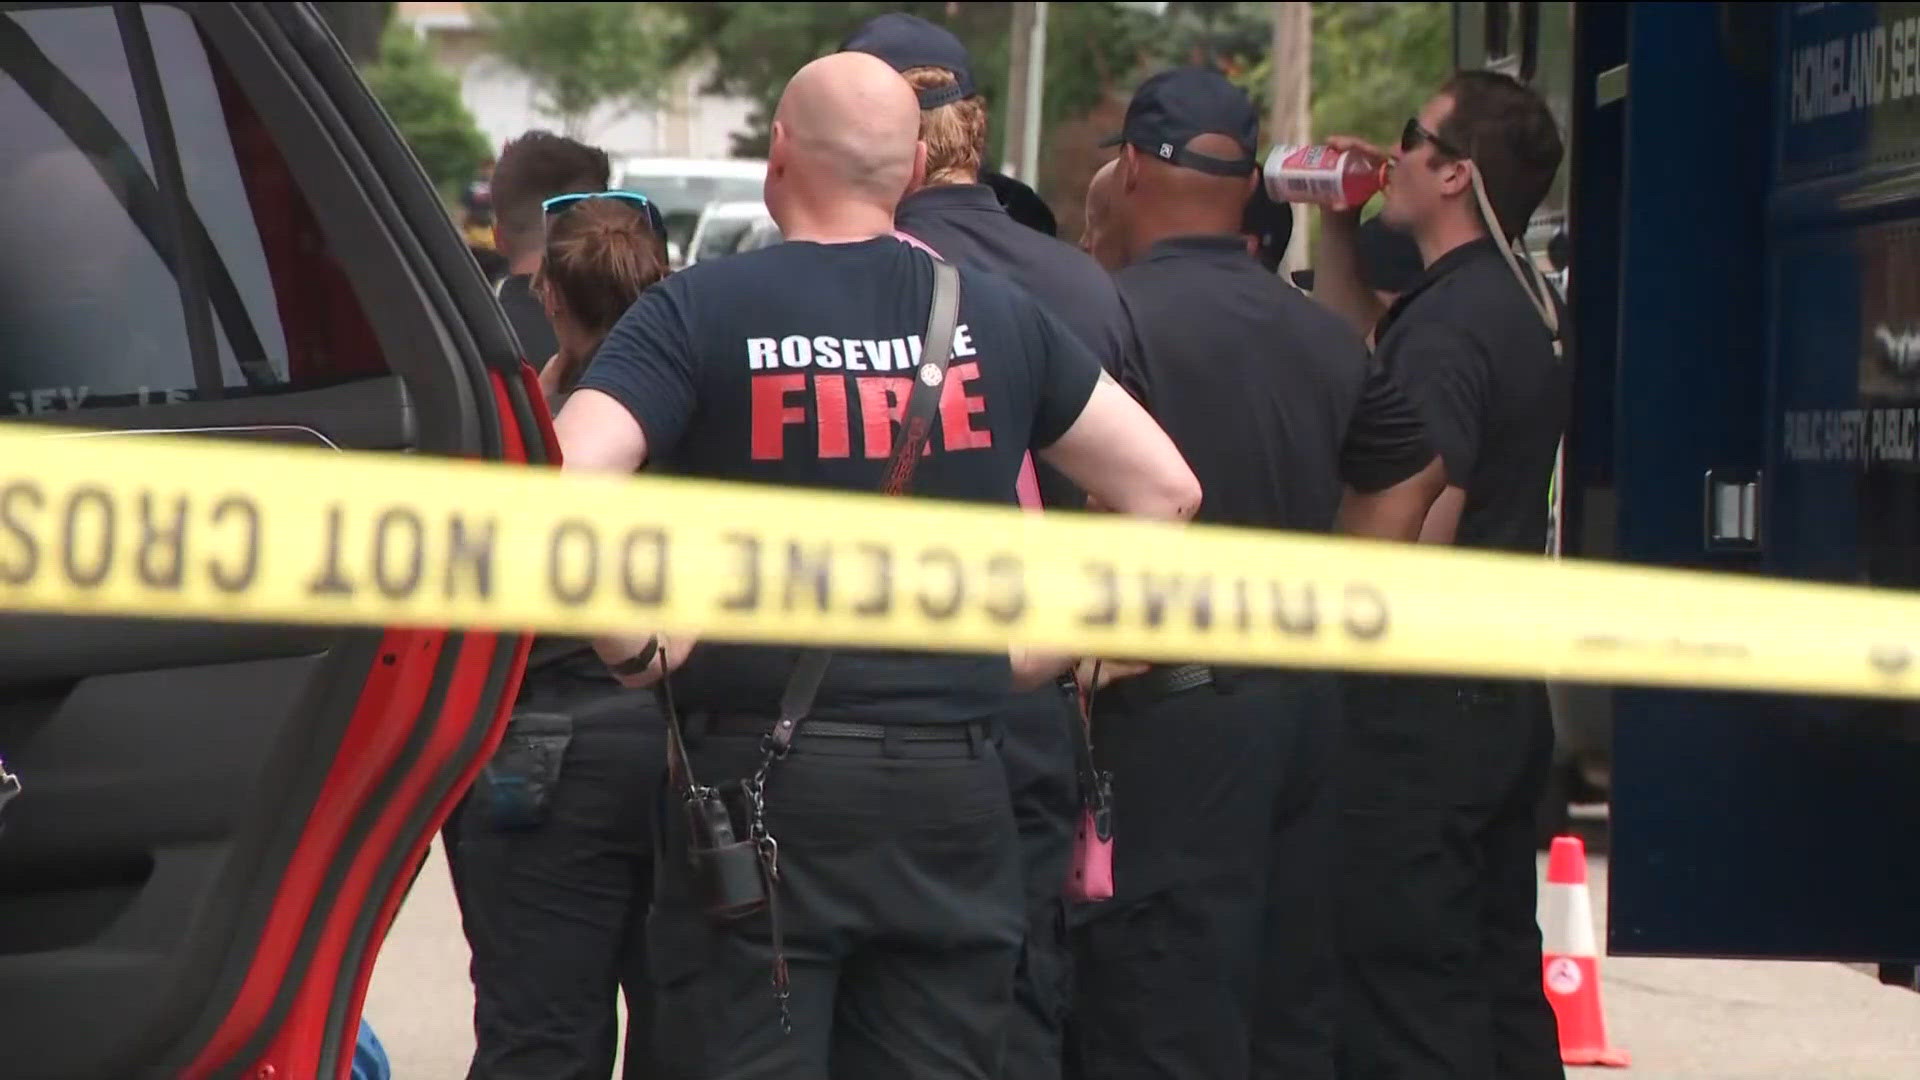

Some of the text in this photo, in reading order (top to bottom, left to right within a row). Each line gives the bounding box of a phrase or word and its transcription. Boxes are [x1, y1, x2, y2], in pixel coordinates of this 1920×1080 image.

[1792, 26, 1886, 124] HOMELAND
[751, 362, 992, 461] FIRE
[1872, 408, 1915, 462] PUBLIC
[308, 500, 497, 601] NOT
[549, 519, 670, 605] DO
[721, 533, 1031, 625] SCENE
[1080, 561, 1389, 642] CRIME
